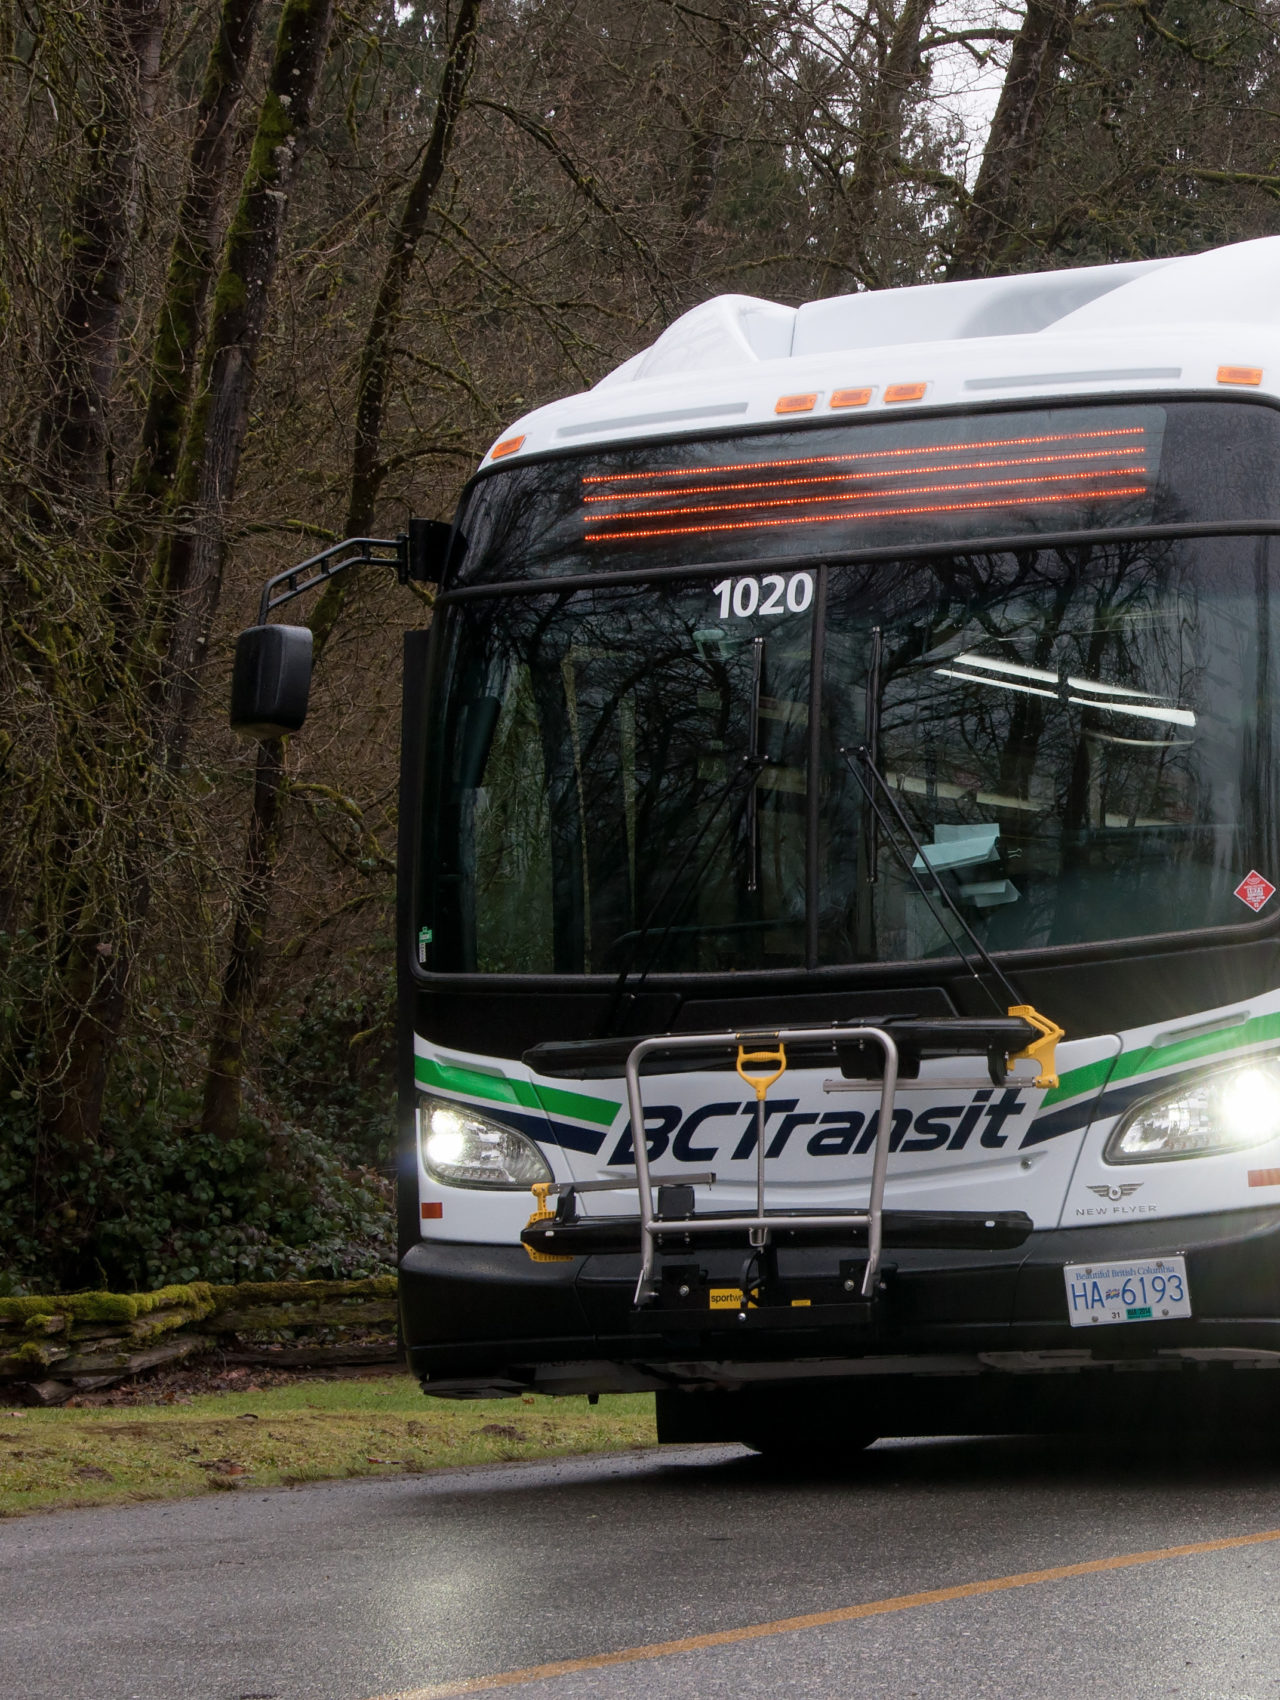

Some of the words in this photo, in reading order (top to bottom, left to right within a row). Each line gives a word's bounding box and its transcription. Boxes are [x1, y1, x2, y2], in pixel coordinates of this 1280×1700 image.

[713, 572, 814, 619] 1020
[1076, 1208, 1107, 1216] NEW
[1113, 1205, 1157, 1214] FLYER
[1075, 1267, 1110, 1281] Beautiful
[1112, 1266, 1137, 1278] British
[1137, 1264, 1175, 1275] Columbia
[1121, 1274, 1184, 1306] 6193
